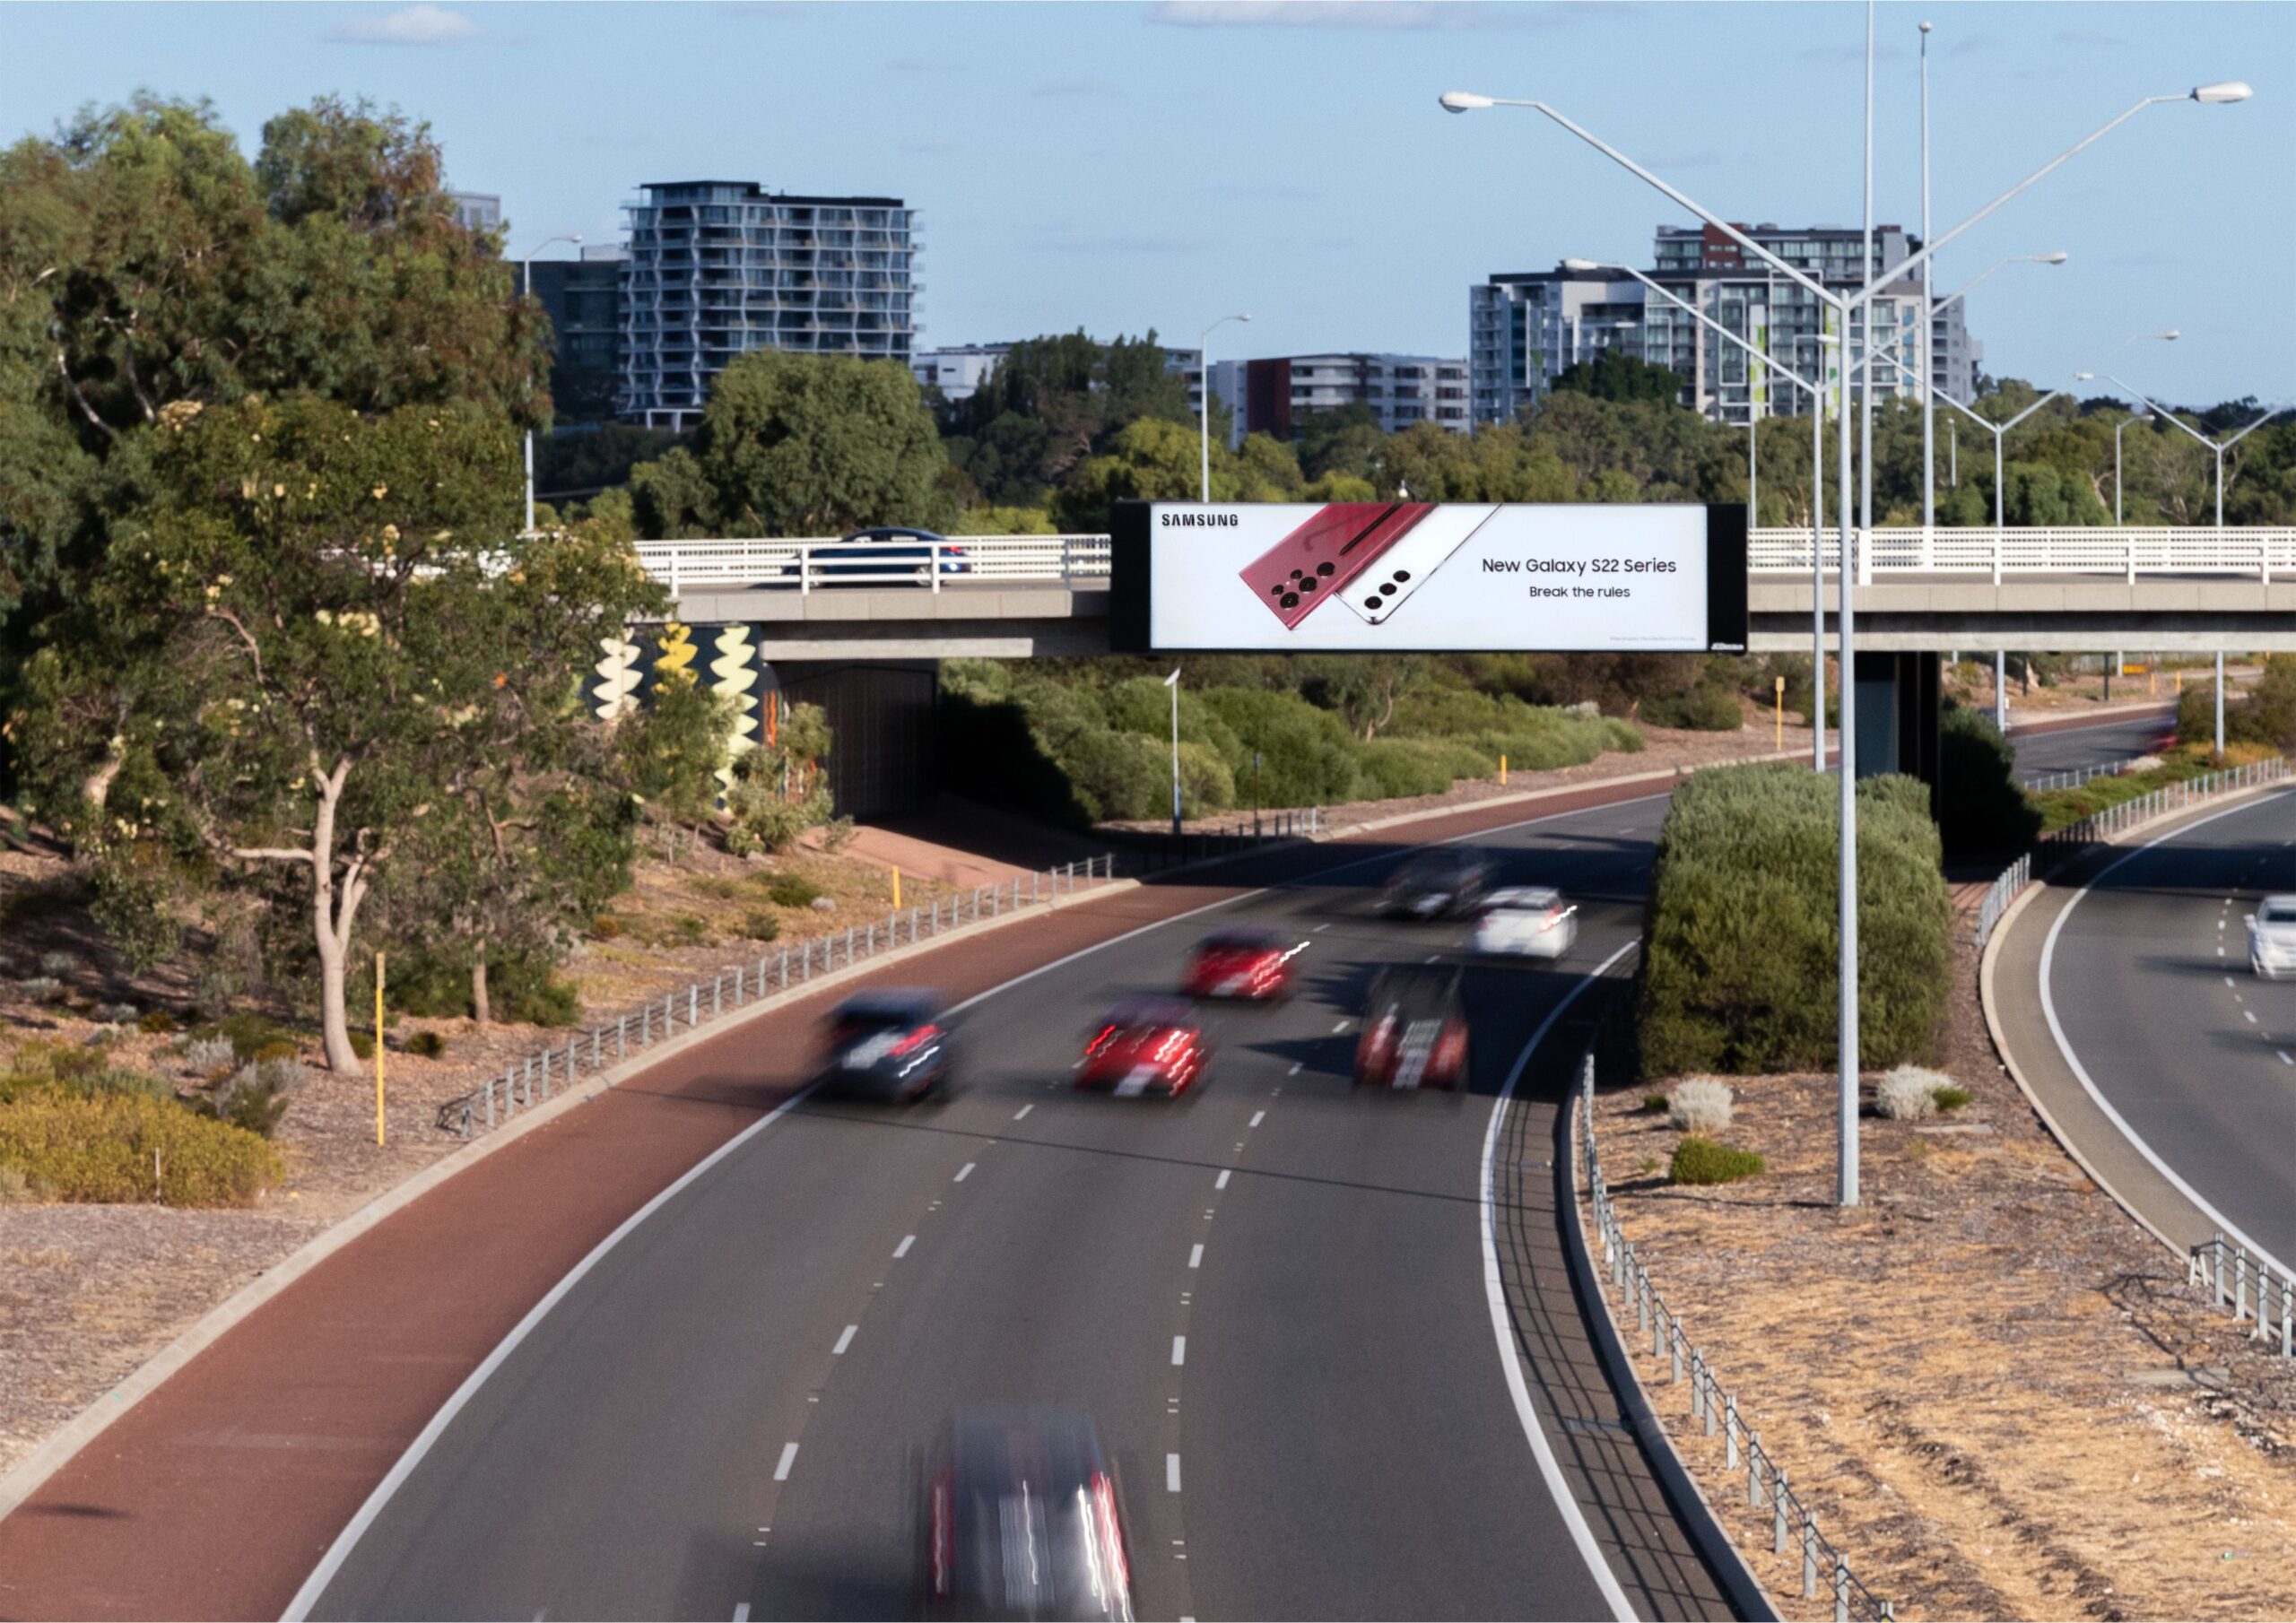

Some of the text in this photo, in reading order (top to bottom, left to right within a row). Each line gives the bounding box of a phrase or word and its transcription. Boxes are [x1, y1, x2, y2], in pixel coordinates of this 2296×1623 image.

[1161, 513, 1239, 527] SAMSUNG
[1483, 557, 1677, 577] New Galaxy S22 Series
[1529, 586, 1631, 598] Break the rules
